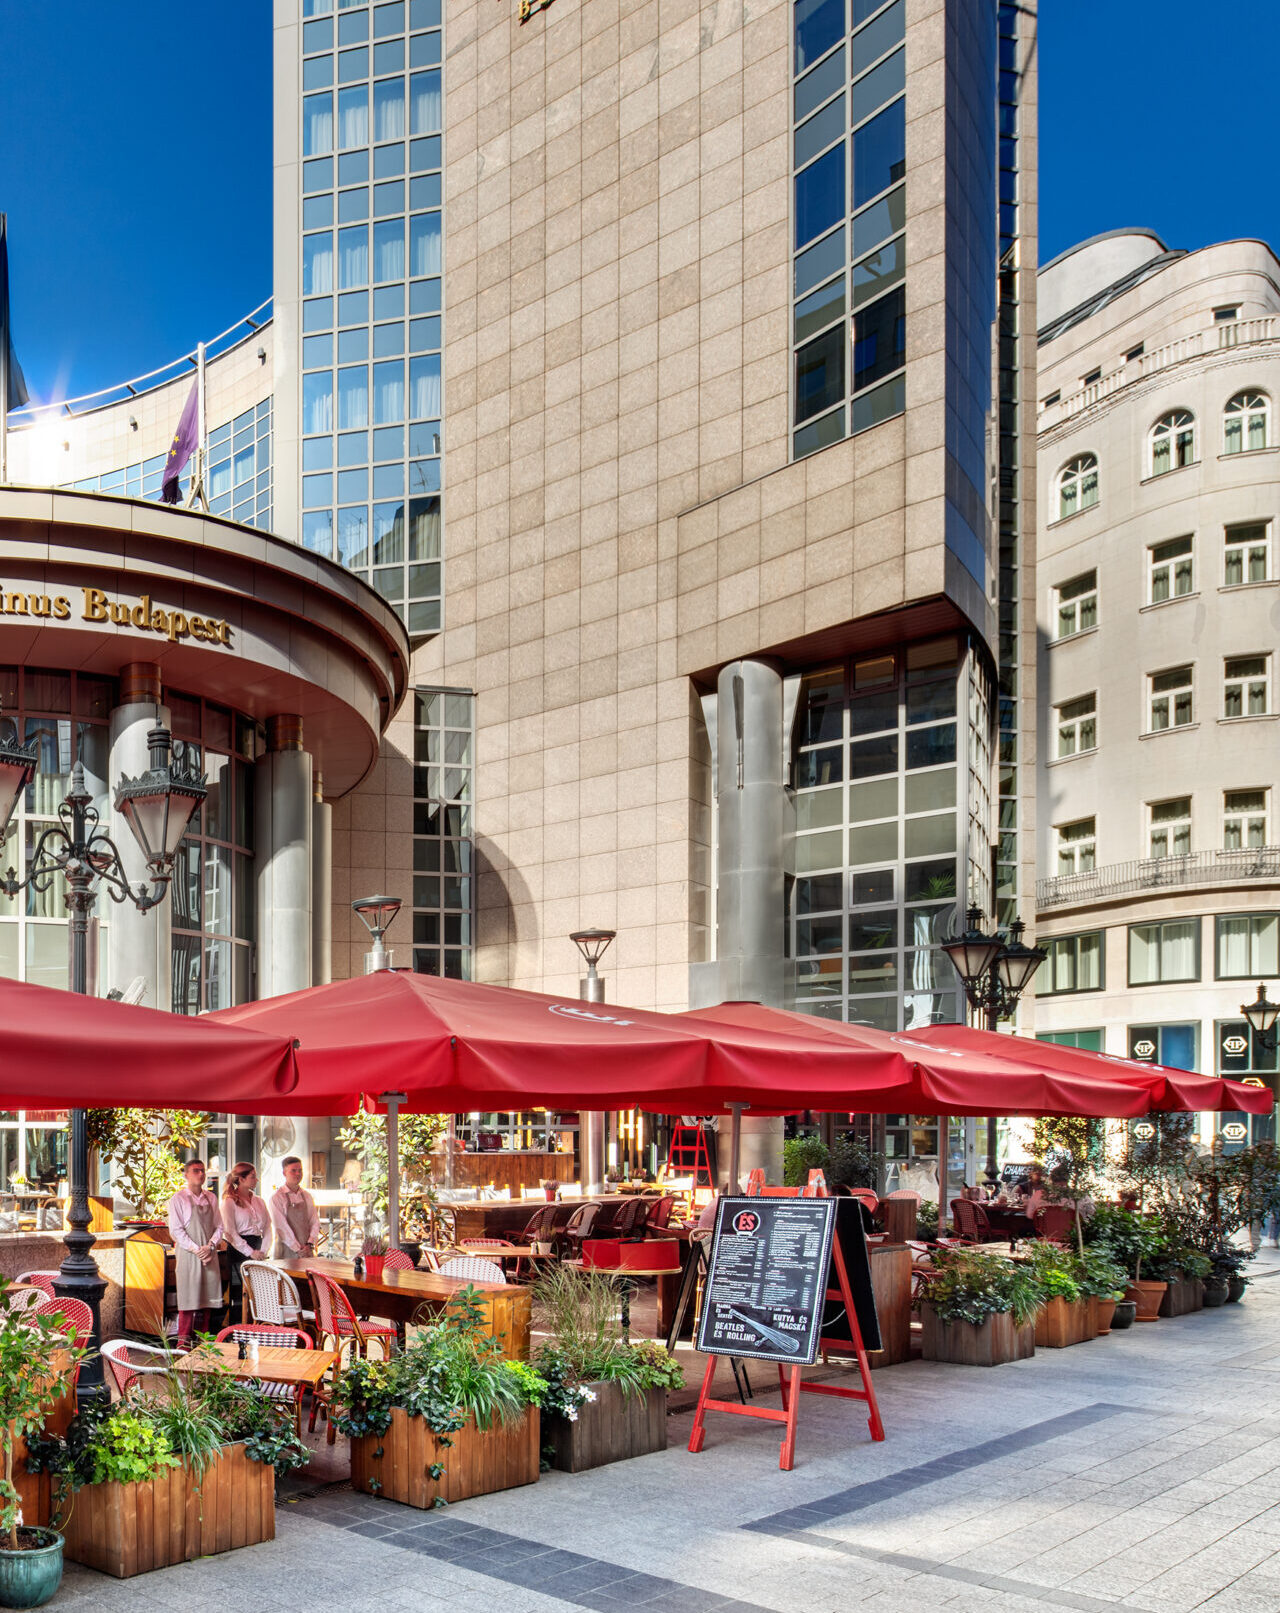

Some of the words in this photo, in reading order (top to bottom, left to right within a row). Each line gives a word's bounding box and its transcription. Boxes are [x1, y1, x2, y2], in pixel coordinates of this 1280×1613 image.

[81, 587, 234, 643] Budapest
[738, 1212, 755, 1230] ÉS
[773, 1313, 795, 1323] KUTYA
[799, 1315, 808, 1324] ÉS
[715, 1321, 745, 1332] BEATLES
[726, 1332, 756, 1342] ROLLING
